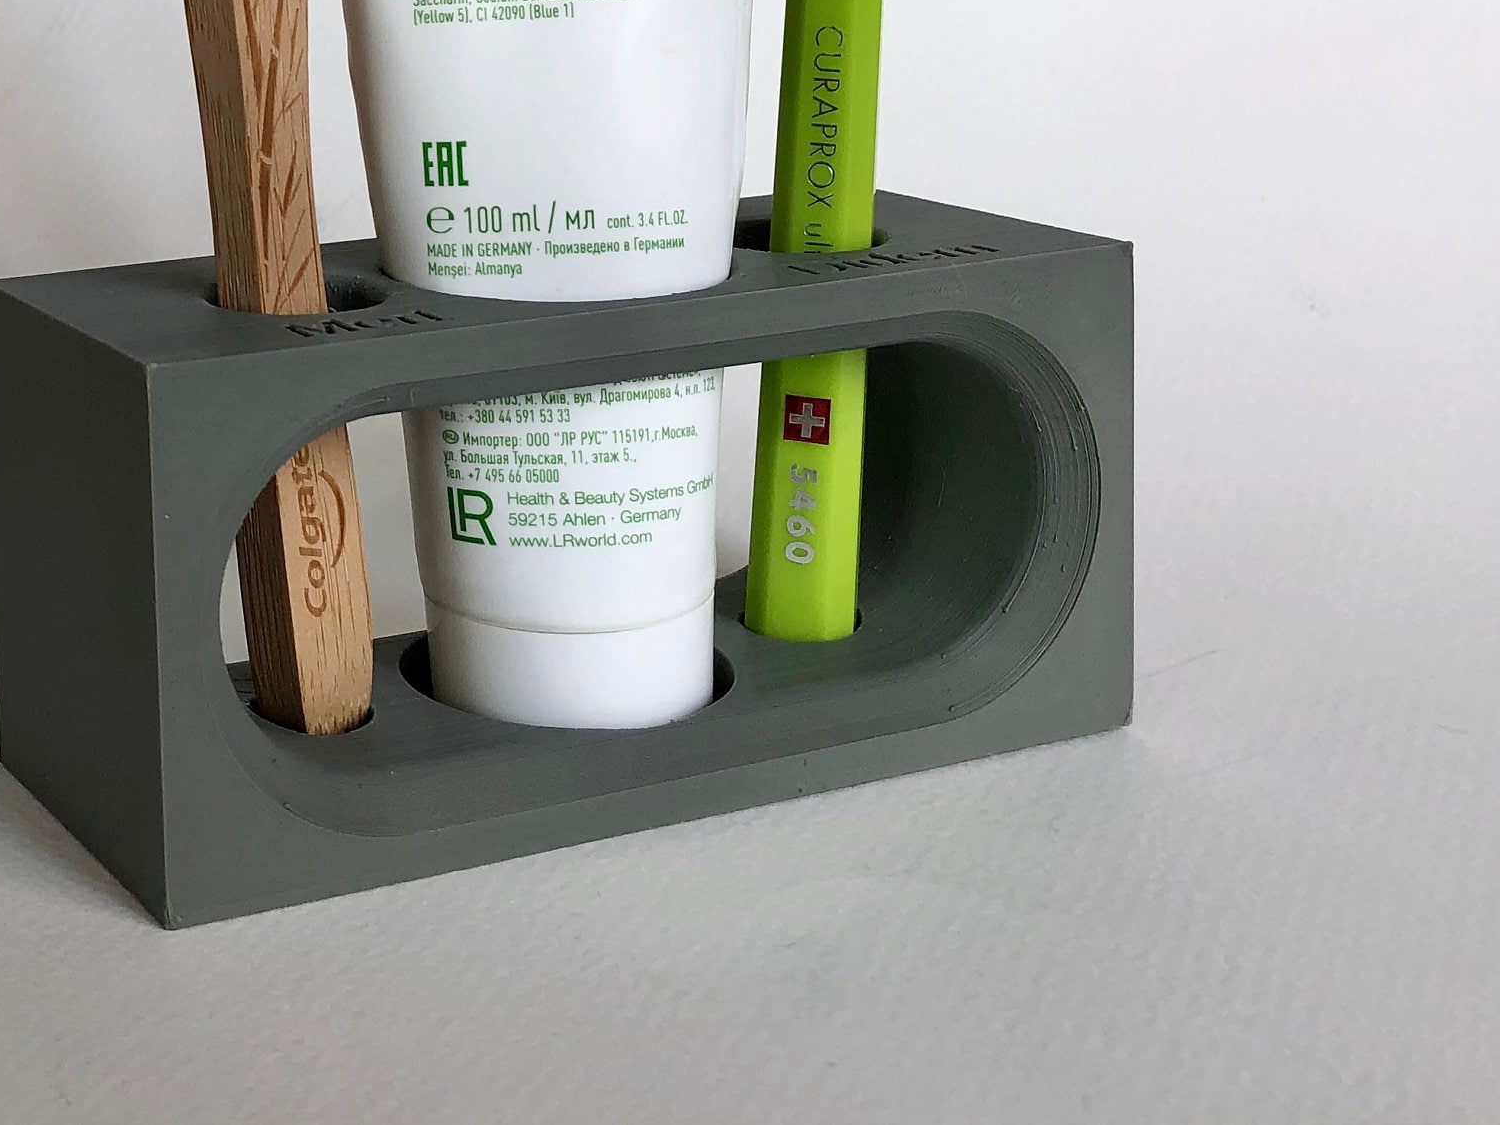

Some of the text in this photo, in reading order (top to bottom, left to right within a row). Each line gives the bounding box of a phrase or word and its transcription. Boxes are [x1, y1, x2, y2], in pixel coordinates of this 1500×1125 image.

[492, 5, 525, 20] 42090
[807, 26, 844, 208] CURAPROX
[464, 206, 502, 233] 100
[512, 204, 540, 232] ml
[607, 215, 634, 229] cont.
[638, 212, 654, 226] 3.4
[427, 237, 684, 258] MADE IN GERMANY Произведено Германии
[475, 262, 522, 278] Almanya
[600, 387, 671, 406] Драгомирова
[499, 410, 512, 423] 44
[516, 409, 534, 423] 591
[540, 409, 553, 423] 53
[558, 409, 570, 422] 33
[460, 449, 509, 464] Большая
[592, 451, 619, 463] этаж
[485, 469, 504, 482] 495
[509, 469, 521, 482] 66
[526, 469, 559, 483] 05000
[508, 491, 554, 505] Health
[575, 491, 625, 506] Beauty
[629, 485, 684, 504] Systems
[687, 472, 714, 494] GmbH
[447, 487, 497, 545] LR
[509, 507, 682, 527] 59215 Ahlen Germany
[785, 463, 818, 564] 5460
[509, 531, 652, 548] www.LRworld.com
